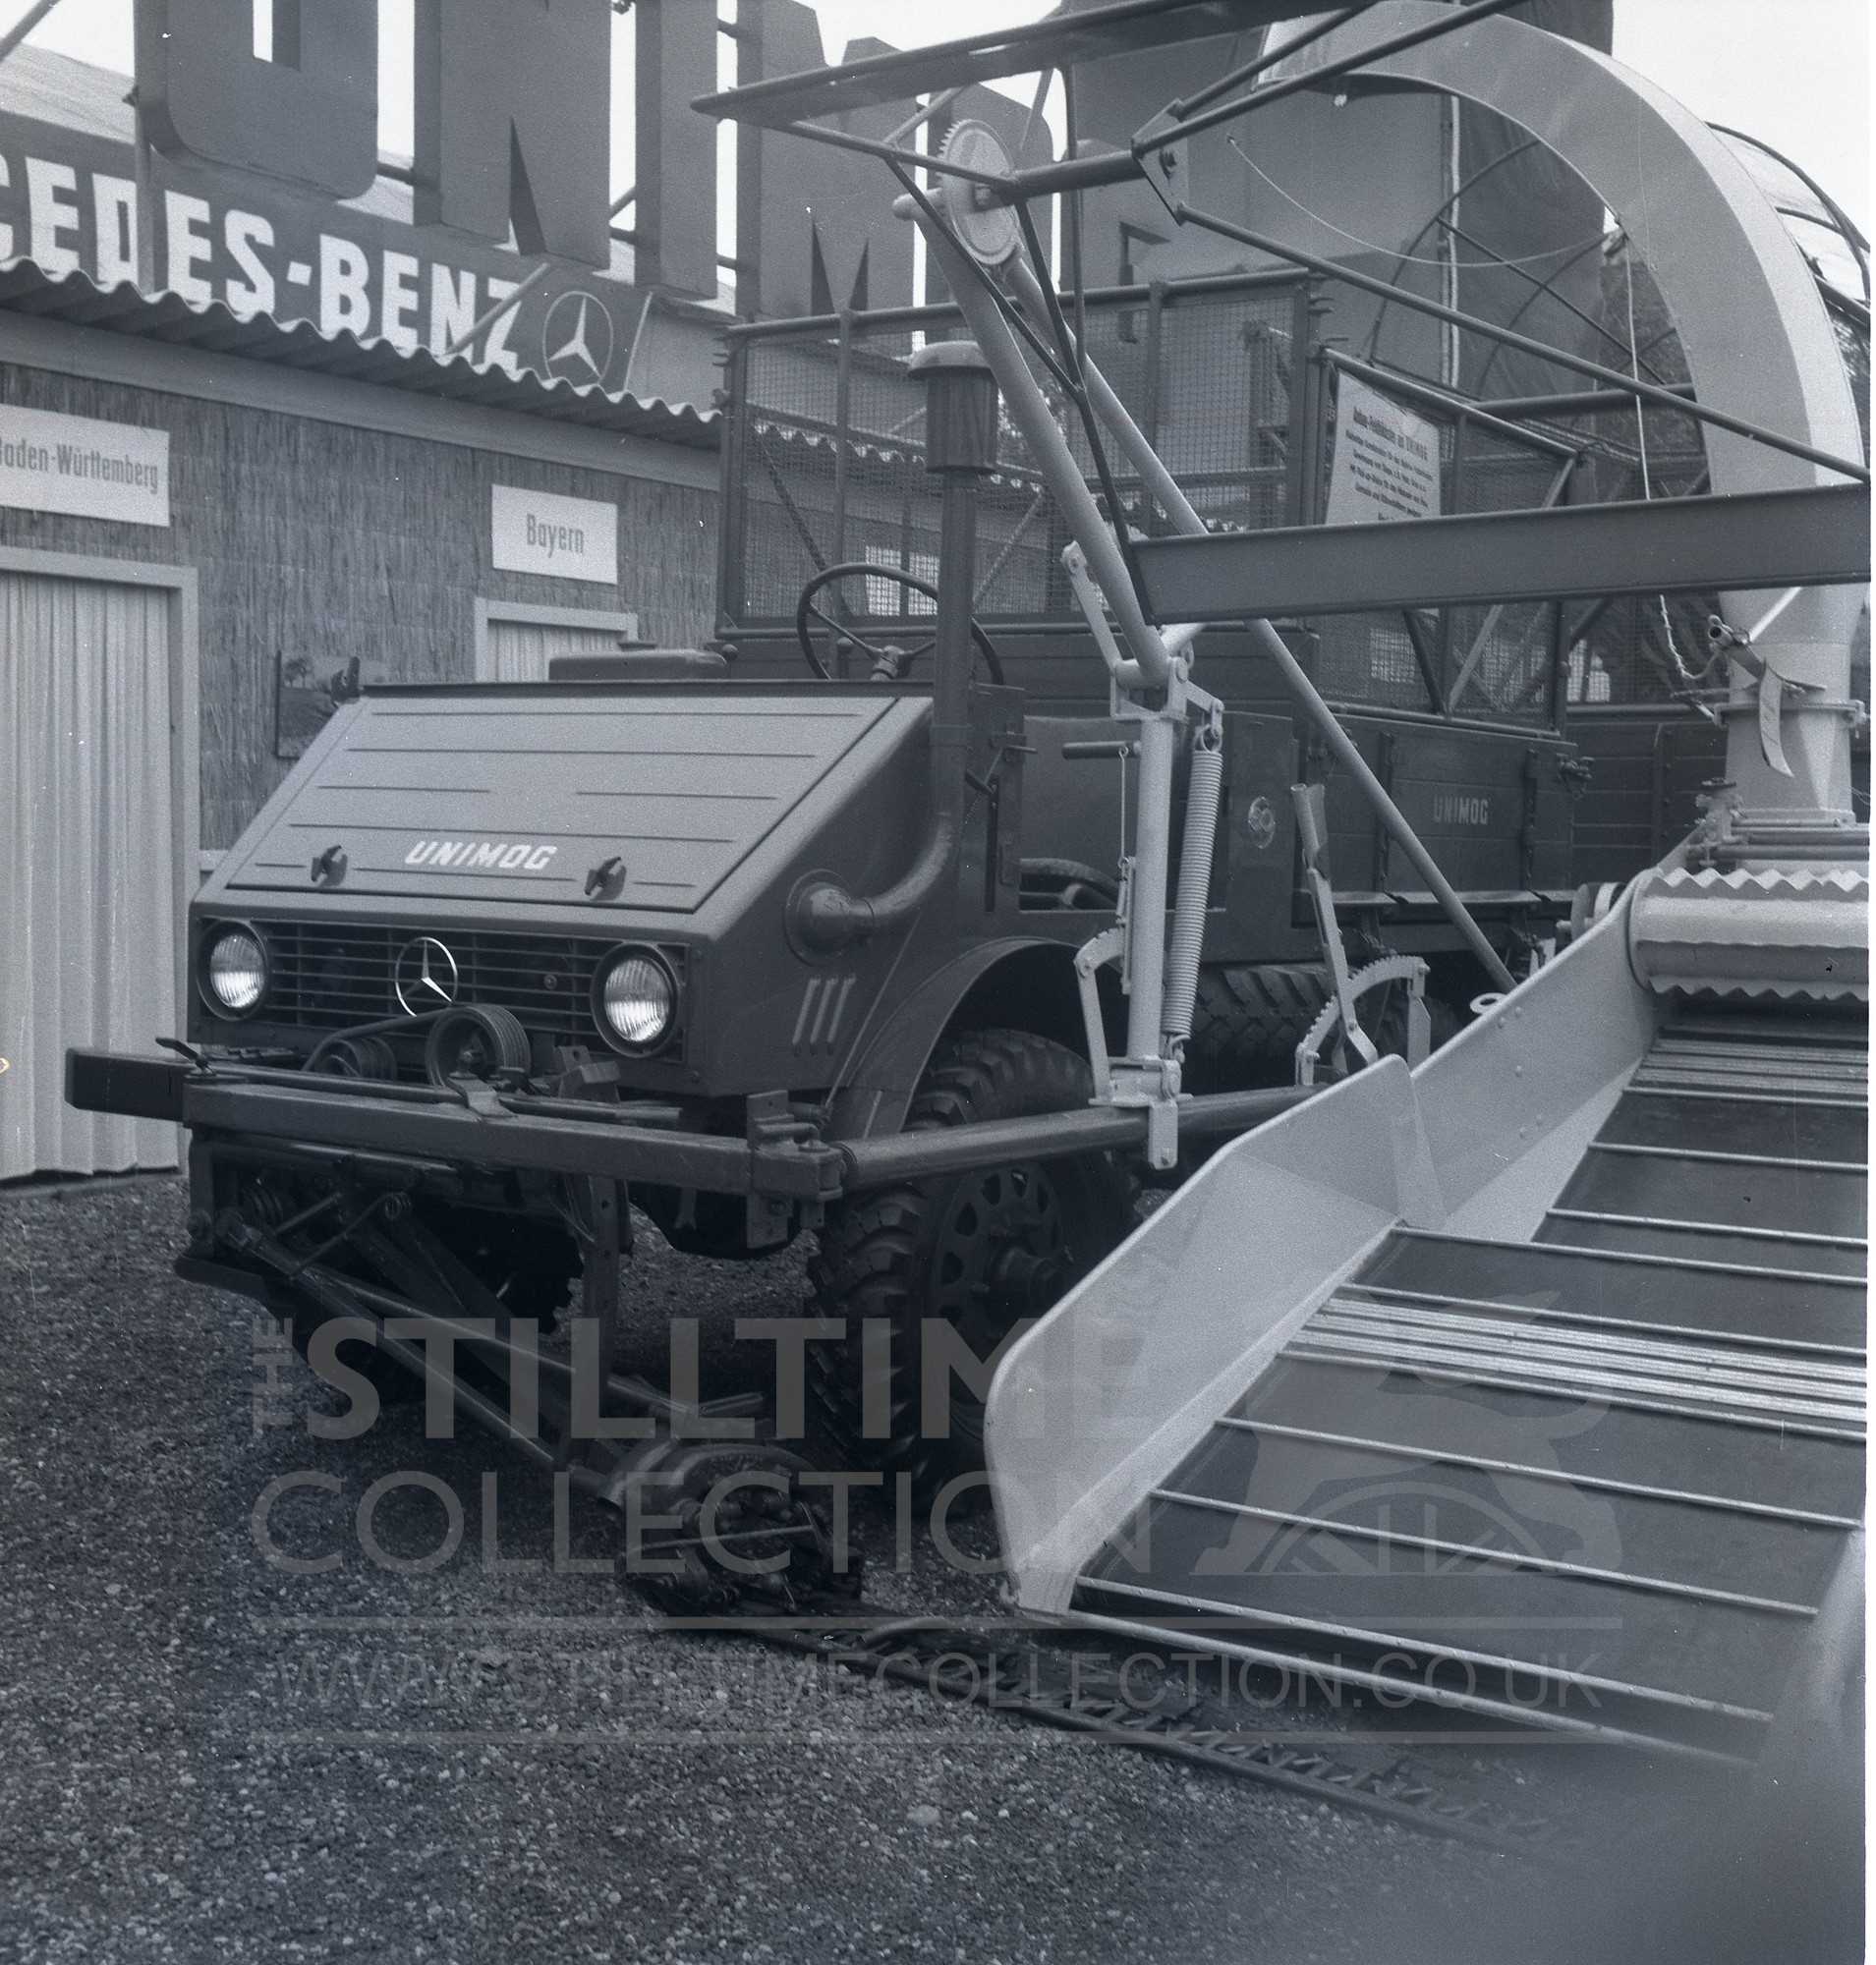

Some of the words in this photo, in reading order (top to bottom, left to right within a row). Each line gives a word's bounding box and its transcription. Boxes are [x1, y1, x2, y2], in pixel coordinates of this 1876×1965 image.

[0, 153, 524, 375] EDES-BENZ
[0, 435, 159, 494] aden-Württemberg
[526, 513, 584, 559] Bayern
[1434, 795, 1488, 825] UNIMOG
[404, 840, 558, 870] UNIMOG
